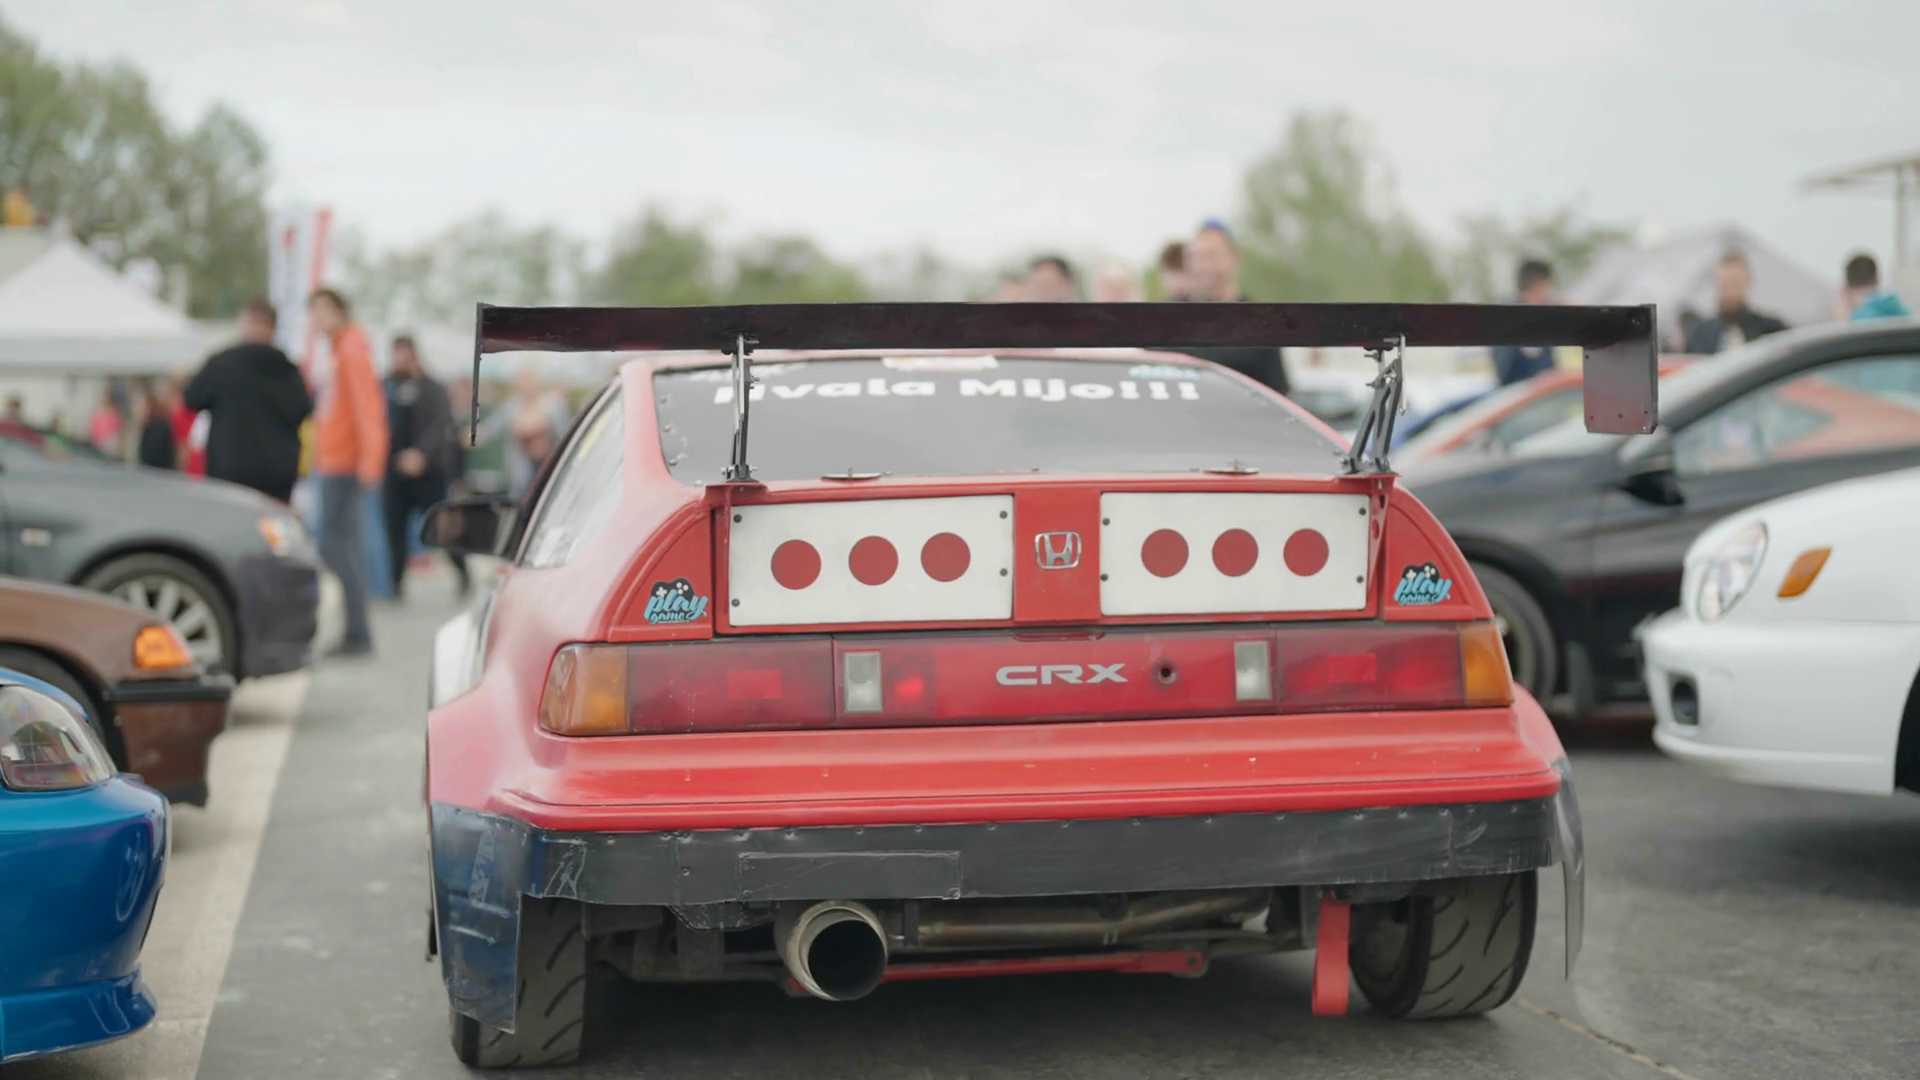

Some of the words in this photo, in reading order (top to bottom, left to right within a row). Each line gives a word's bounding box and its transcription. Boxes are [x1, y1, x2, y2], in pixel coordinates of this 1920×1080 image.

[1393, 571, 1453, 603] play
[643, 588, 709, 620] play
[995, 663, 1129, 686] CRX
